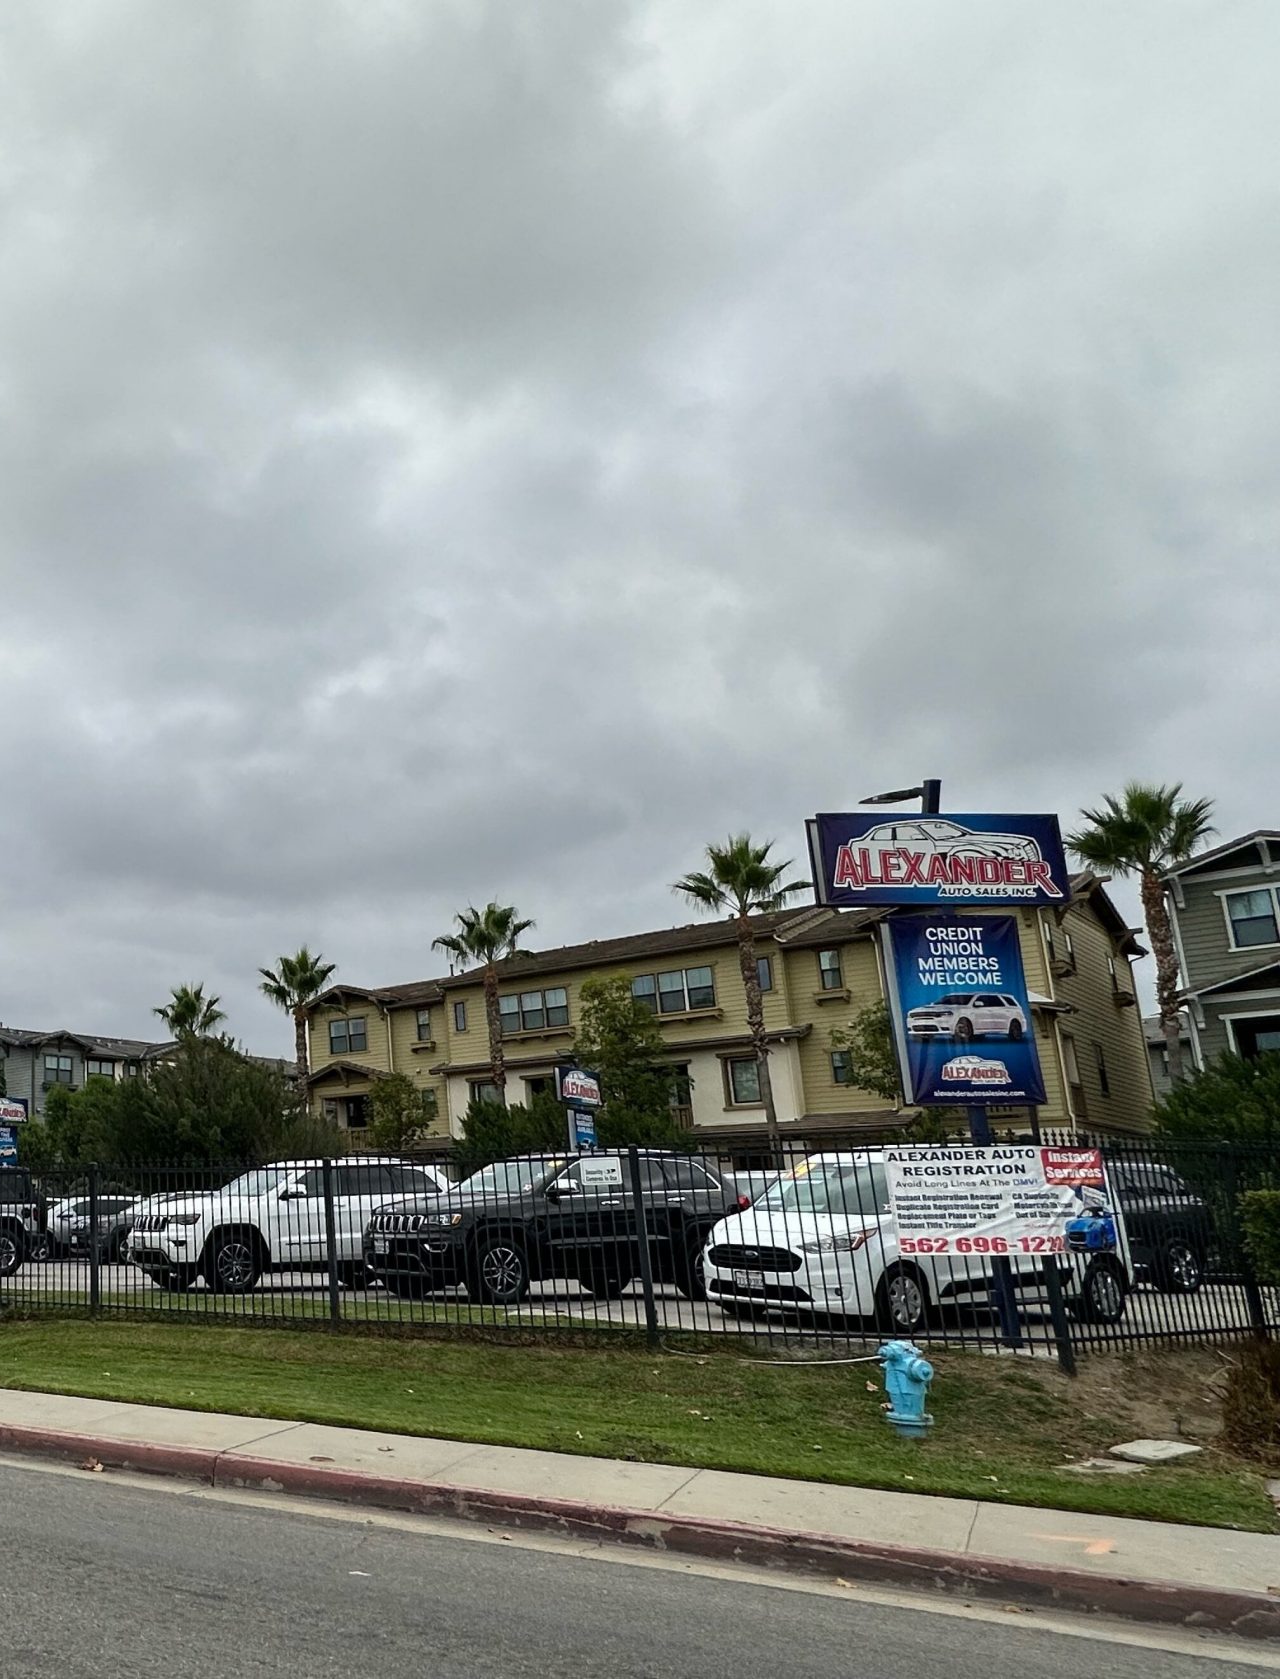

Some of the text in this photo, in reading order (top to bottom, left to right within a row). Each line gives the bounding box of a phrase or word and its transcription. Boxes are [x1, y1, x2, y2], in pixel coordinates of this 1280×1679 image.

[834, 845, 1063, 897] ALEXANDER
[939, 887, 971, 896] AUTO
[975, 887, 1008, 896] SALES
[925, 927, 983, 941] CREDIT
[929, 942, 984, 955] UNION
[918, 957, 999, 970] MEMBERS
[918, 972, 1003, 986] WELCOME
[942, 1065, 1012, 1083] ALEXANDER
[888, 1149, 1035, 1162] ALEXANDER AUTO
[1048, 1150, 1097, 1163] Instant
[903, 1164, 1026, 1176] REGISTRATION
[1045, 1166, 1102, 1178] Services
[895, 1180, 922, 1188] Avoid
[924, 1180, 949, 1189] Long
[950, 1179, 977, 1188] Lines
[980, 1179, 990, 1187] At
[922, 1194, 969, 1202] Registration
[896, 1202, 999, 1211] Duplicate Registration Card
[948, 1212, 967, 1220] Plate
[977, 1212, 997, 1220] Tags
[900, 1237, 949, 1253] 562
